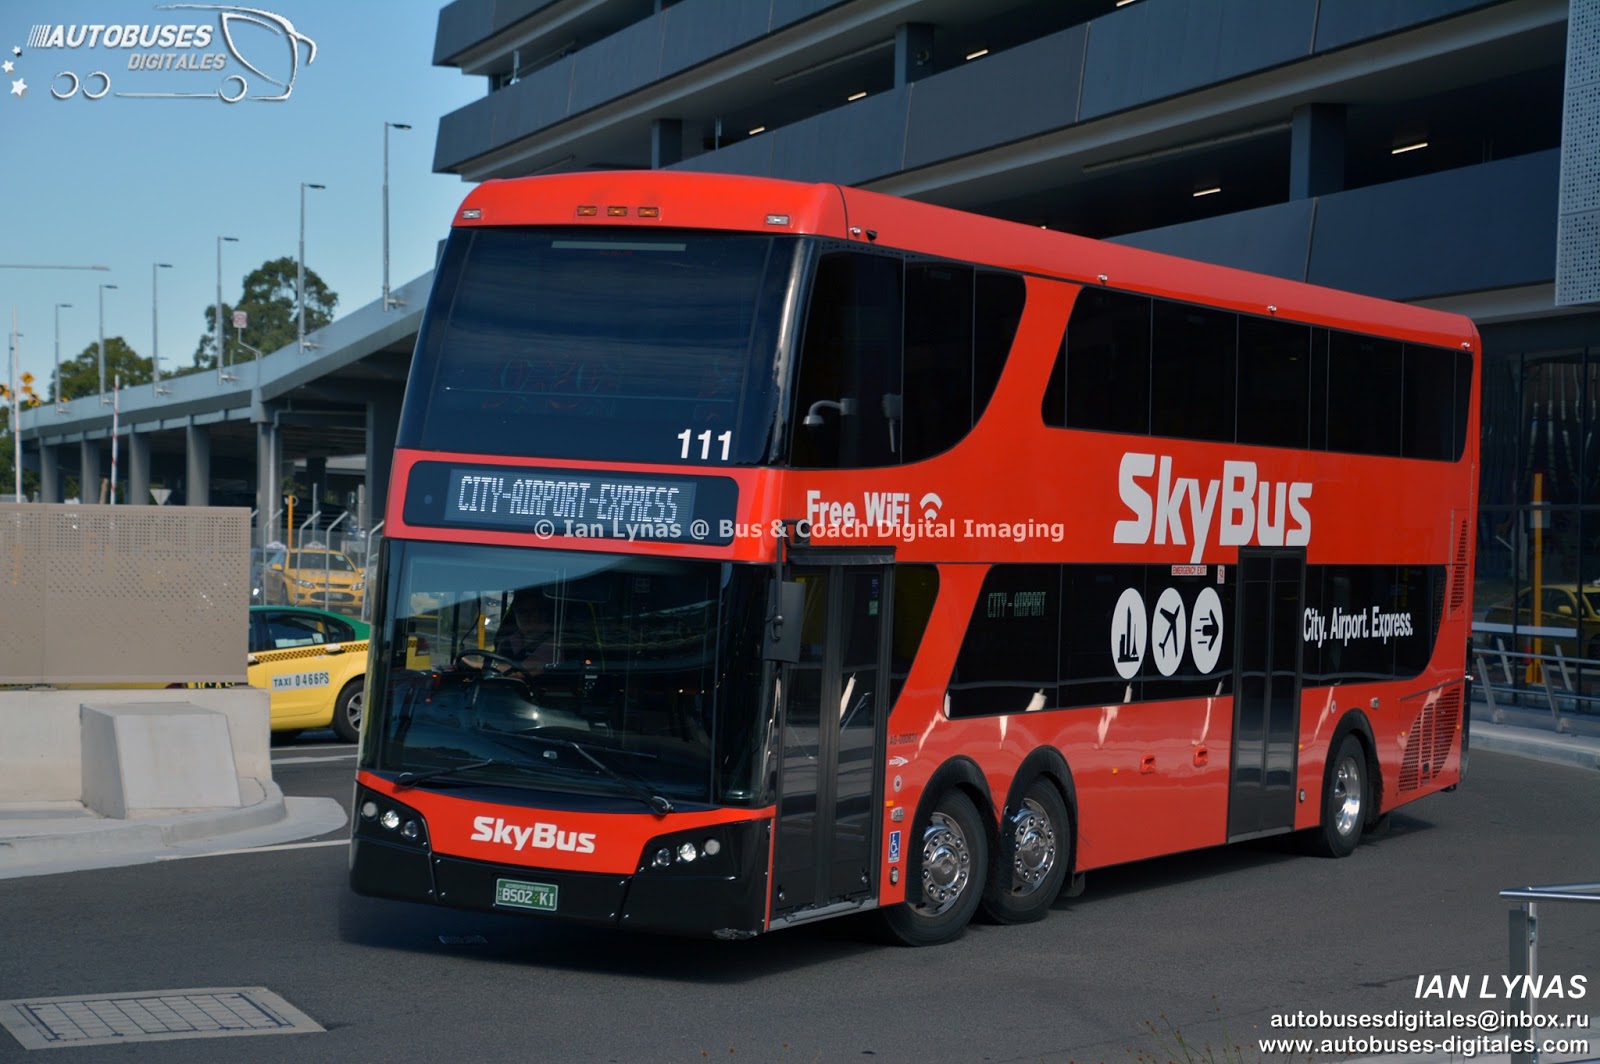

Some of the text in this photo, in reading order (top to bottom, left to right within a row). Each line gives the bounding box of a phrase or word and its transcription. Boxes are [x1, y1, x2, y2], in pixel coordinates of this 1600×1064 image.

[677, 429, 732, 461] 111
[807, 490, 910, 527] Free WiFi
[1113, 452, 1313, 564] SkyBus
[1303, 606, 1414, 648] City. Airport. Express.
[273, 678, 292, 687] TAXI
[470, 815, 597, 854] SkyBus
[503, 888, 532, 903] BS02
